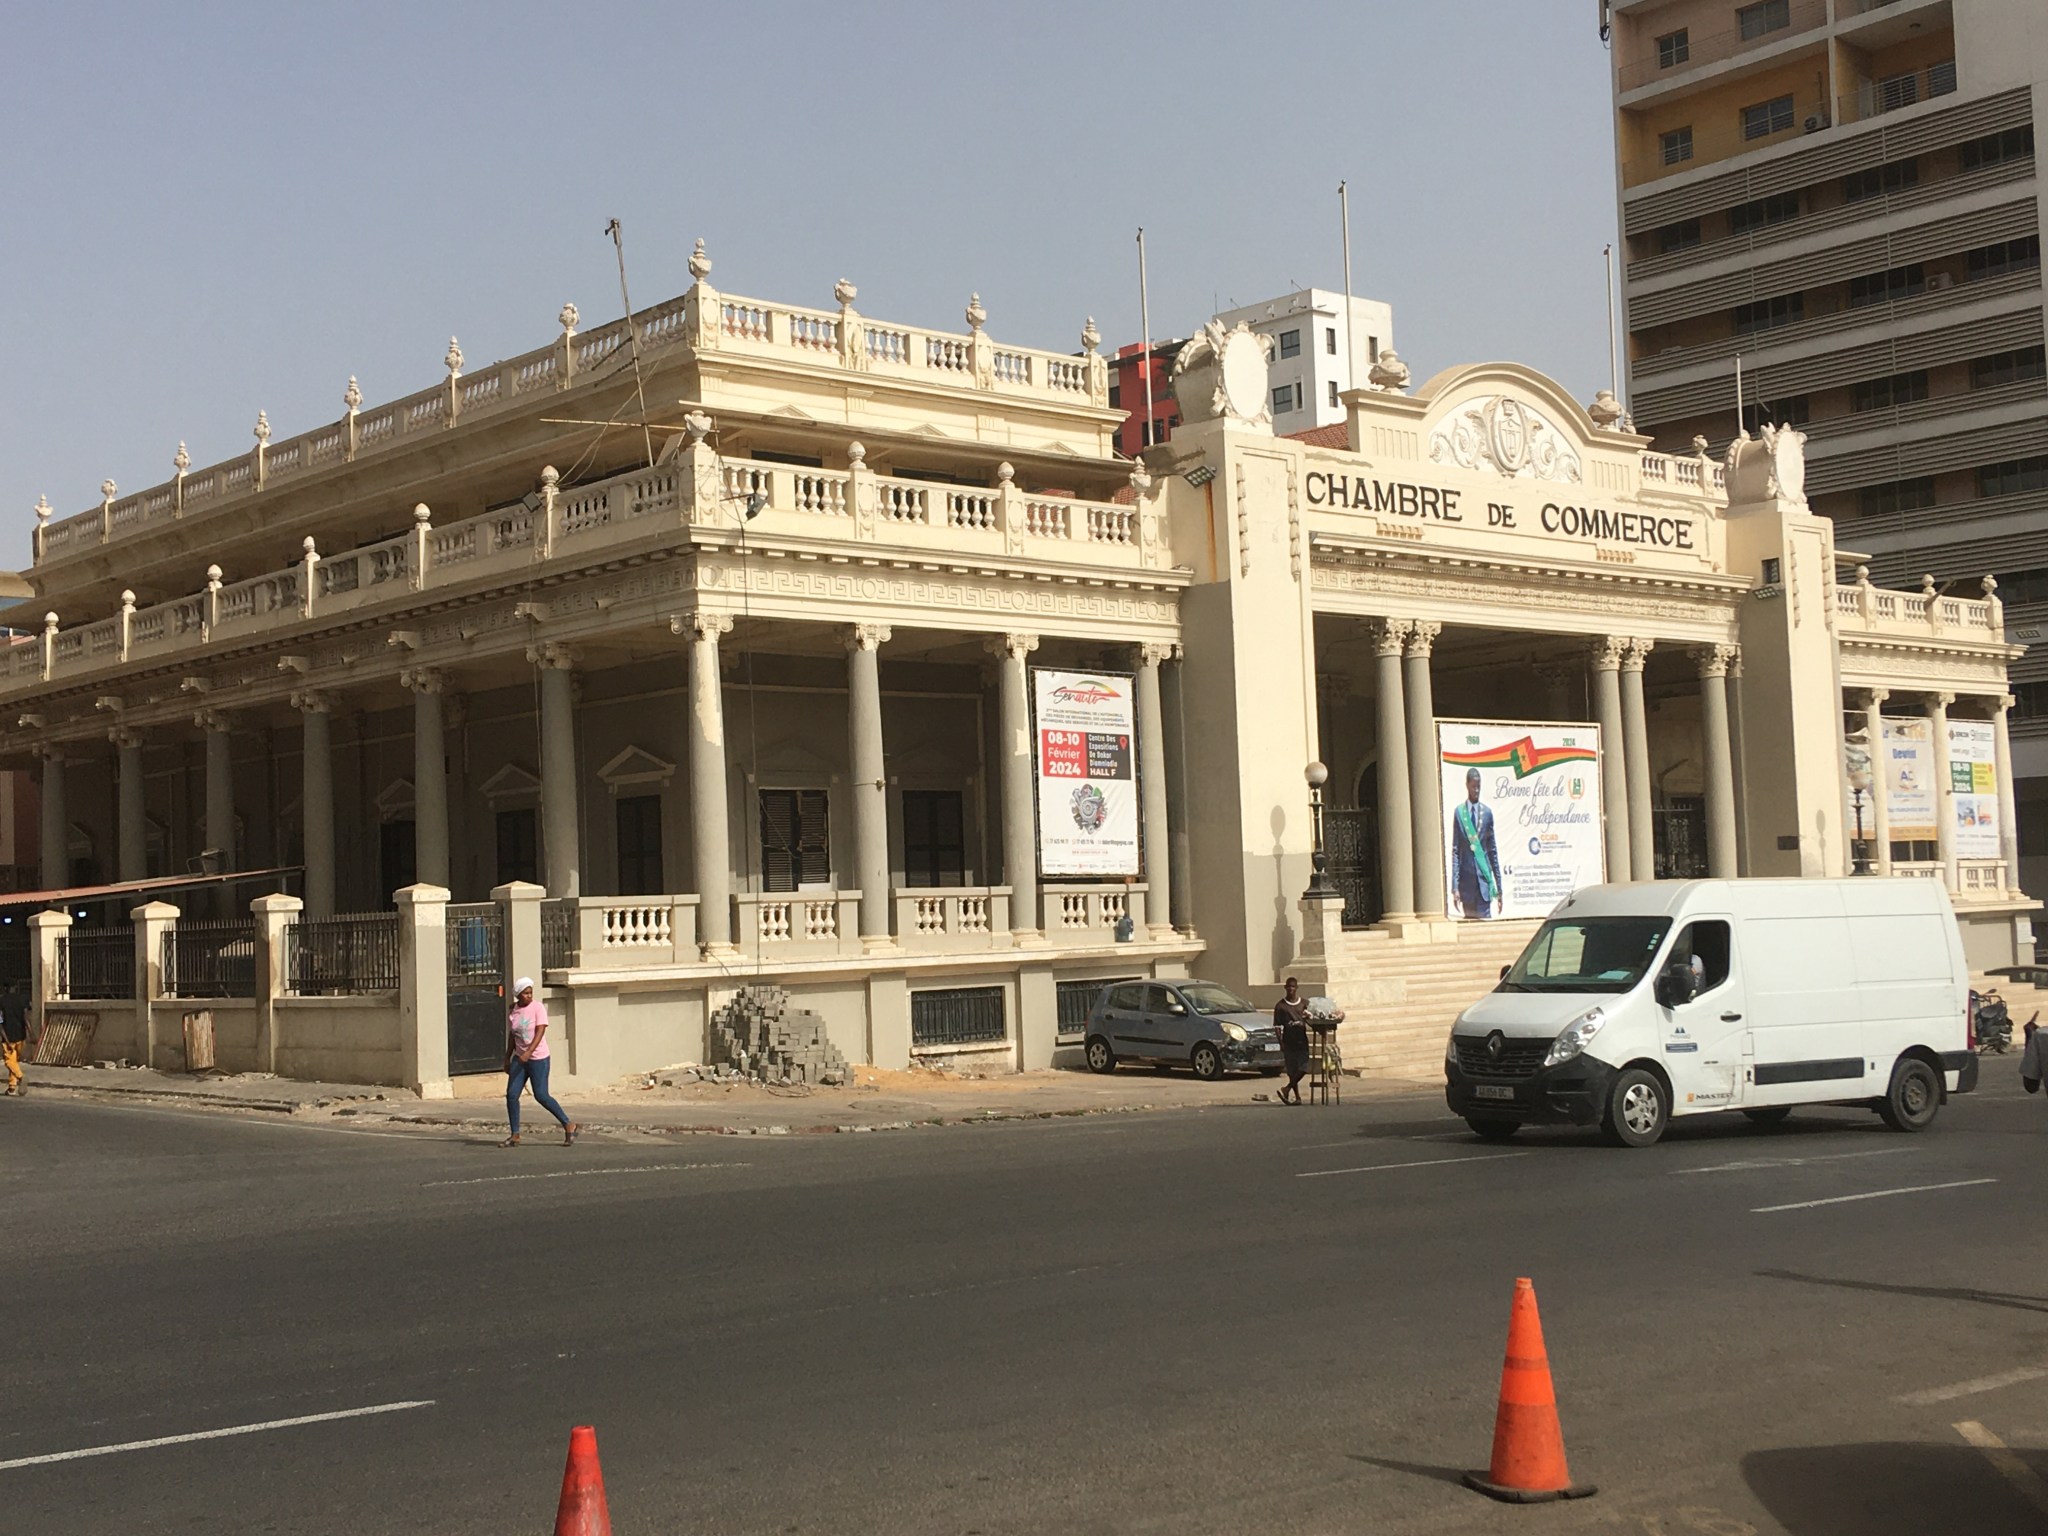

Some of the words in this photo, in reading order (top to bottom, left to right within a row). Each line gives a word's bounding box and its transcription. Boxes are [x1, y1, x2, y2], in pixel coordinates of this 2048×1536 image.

[1306, 472, 1462, 522] CHAMBRE
[1488, 503, 1517, 528] DE
[1541, 502, 1693, 549] COMMERCE
[1047, 731, 1080, 746] 08-10
[1088, 734, 1105, 742] Centre
[1106, 735, 1116, 743] Des
[1465, 735, 1480, 745] 1960
[1563, 738, 1576, 747] 2024
[1088, 742, 1119, 751] Expositions
[1047, 747, 1080, 759] Février
[1097, 751, 1112, 759] Dakar
[1049, 760, 1081, 776] 2024
[1090, 768, 1110, 776] HALL
[1493, 776, 1531, 799] Bonne
[1531, 777, 1551, 804] fête
[1552, 775, 1565, 797] de
[1519, 803, 1591, 833] l'Indépendance
